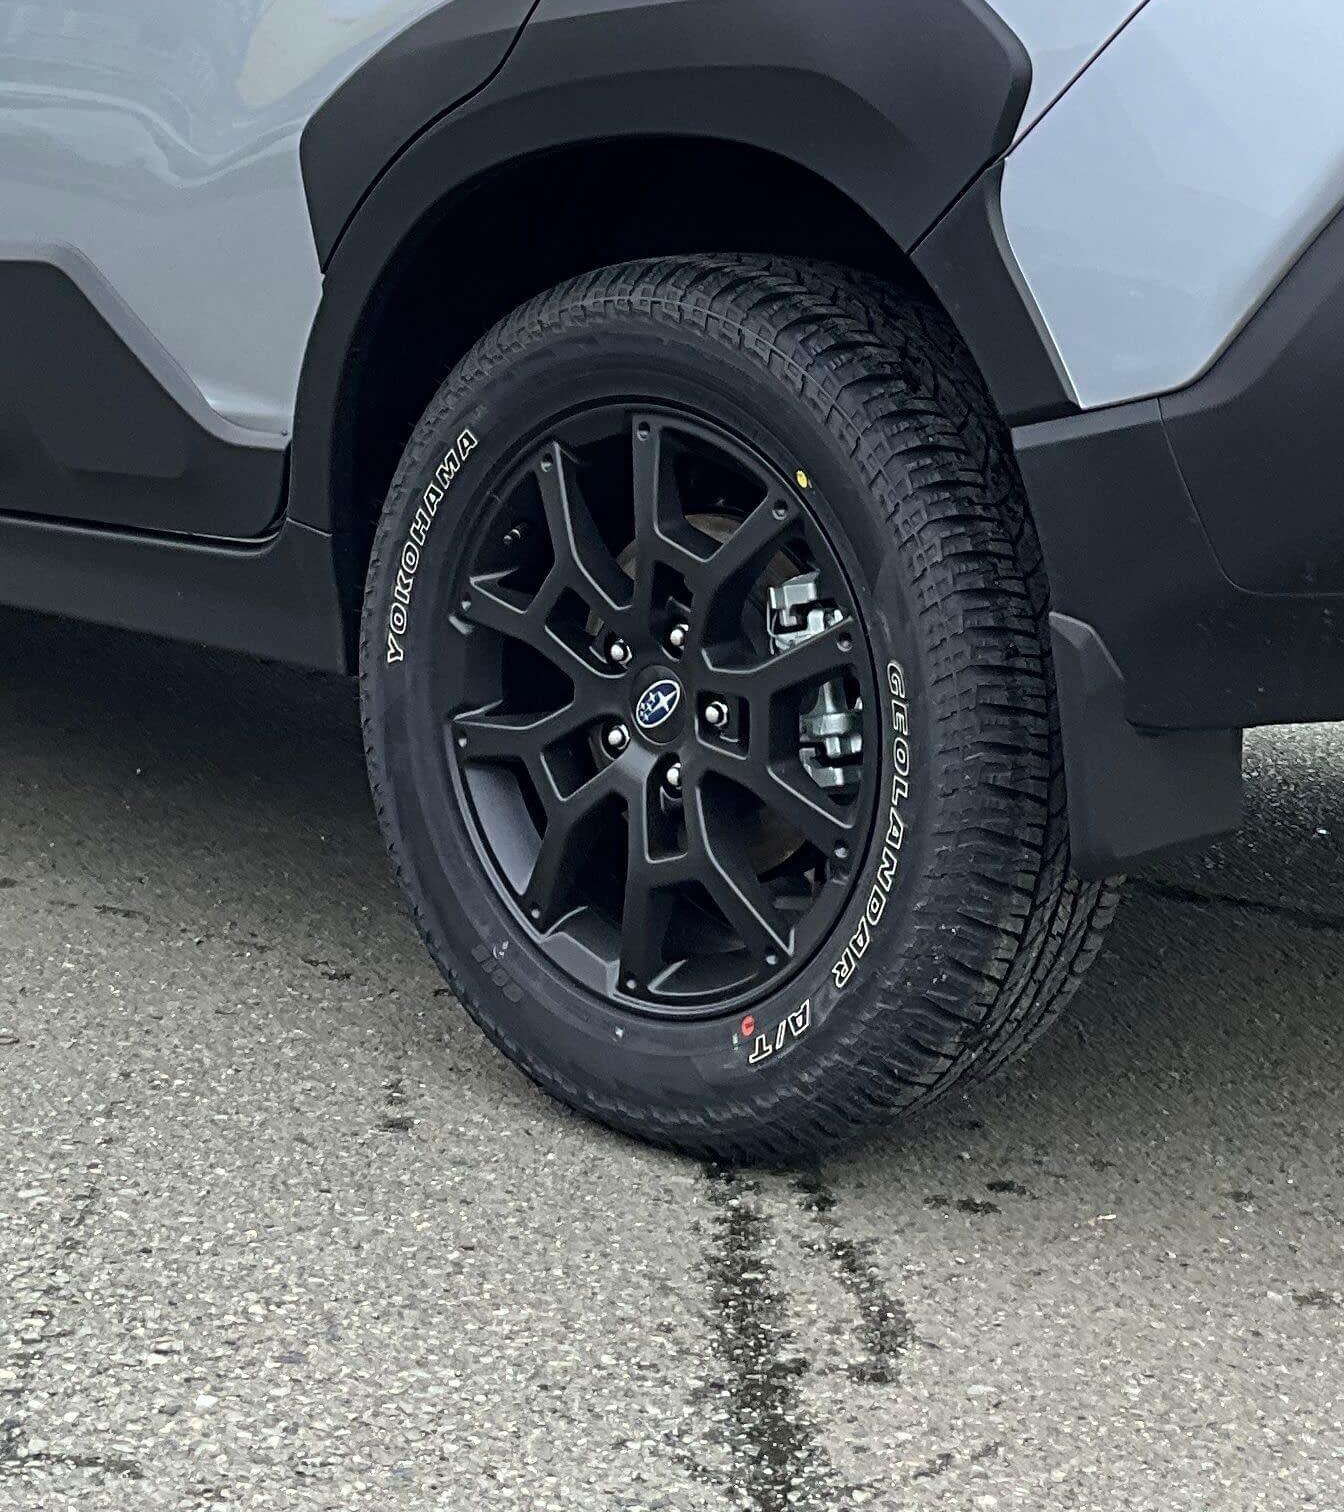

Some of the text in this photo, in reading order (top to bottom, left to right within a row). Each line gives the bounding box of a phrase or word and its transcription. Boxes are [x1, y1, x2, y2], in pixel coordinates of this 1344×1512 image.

[387, 429, 478, 663] YOKOHAMA
[749, 660, 909, 1063] GEOLANDAR A/T
